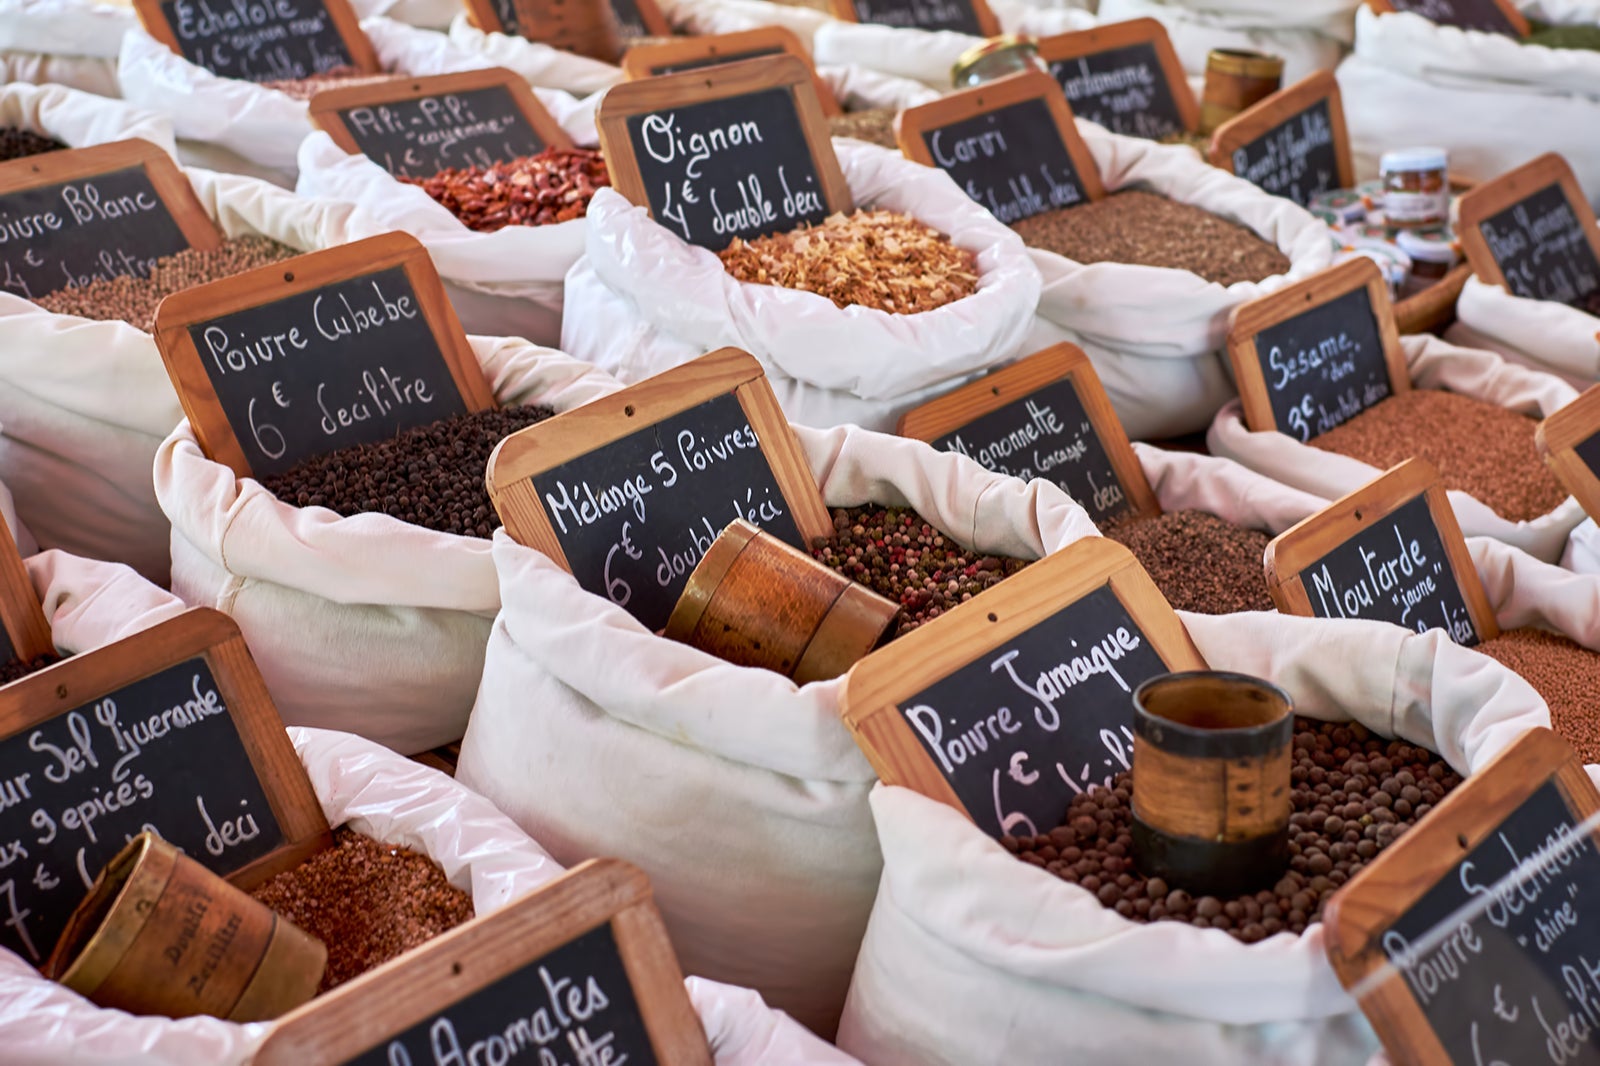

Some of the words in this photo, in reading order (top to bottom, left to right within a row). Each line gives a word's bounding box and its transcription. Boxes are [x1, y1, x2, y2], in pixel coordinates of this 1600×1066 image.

[642, 113, 764, 179] Oignon
[62, 182, 156, 226] Blanc
[710, 173, 777, 234] double
[204, 326, 308, 374] Poivre
[313, 281, 418, 341] Cubebe
[316, 366, 434, 435] decilitre
[546, 475, 653, 534] Mélange
[650, 451, 678, 487] 5
[677, 424, 760, 472] Poivres
[1312, 524, 1427, 618] Moutarde
[29, 711, 99, 783] Sel
[905, 704, 1022, 773] Poivre
[30, 807, 57, 844] 9
[197, 795, 260, 856] deci
[1383, 921, 1482, 1005] Poivre
[430, 966, 609, 1066] Aromates
